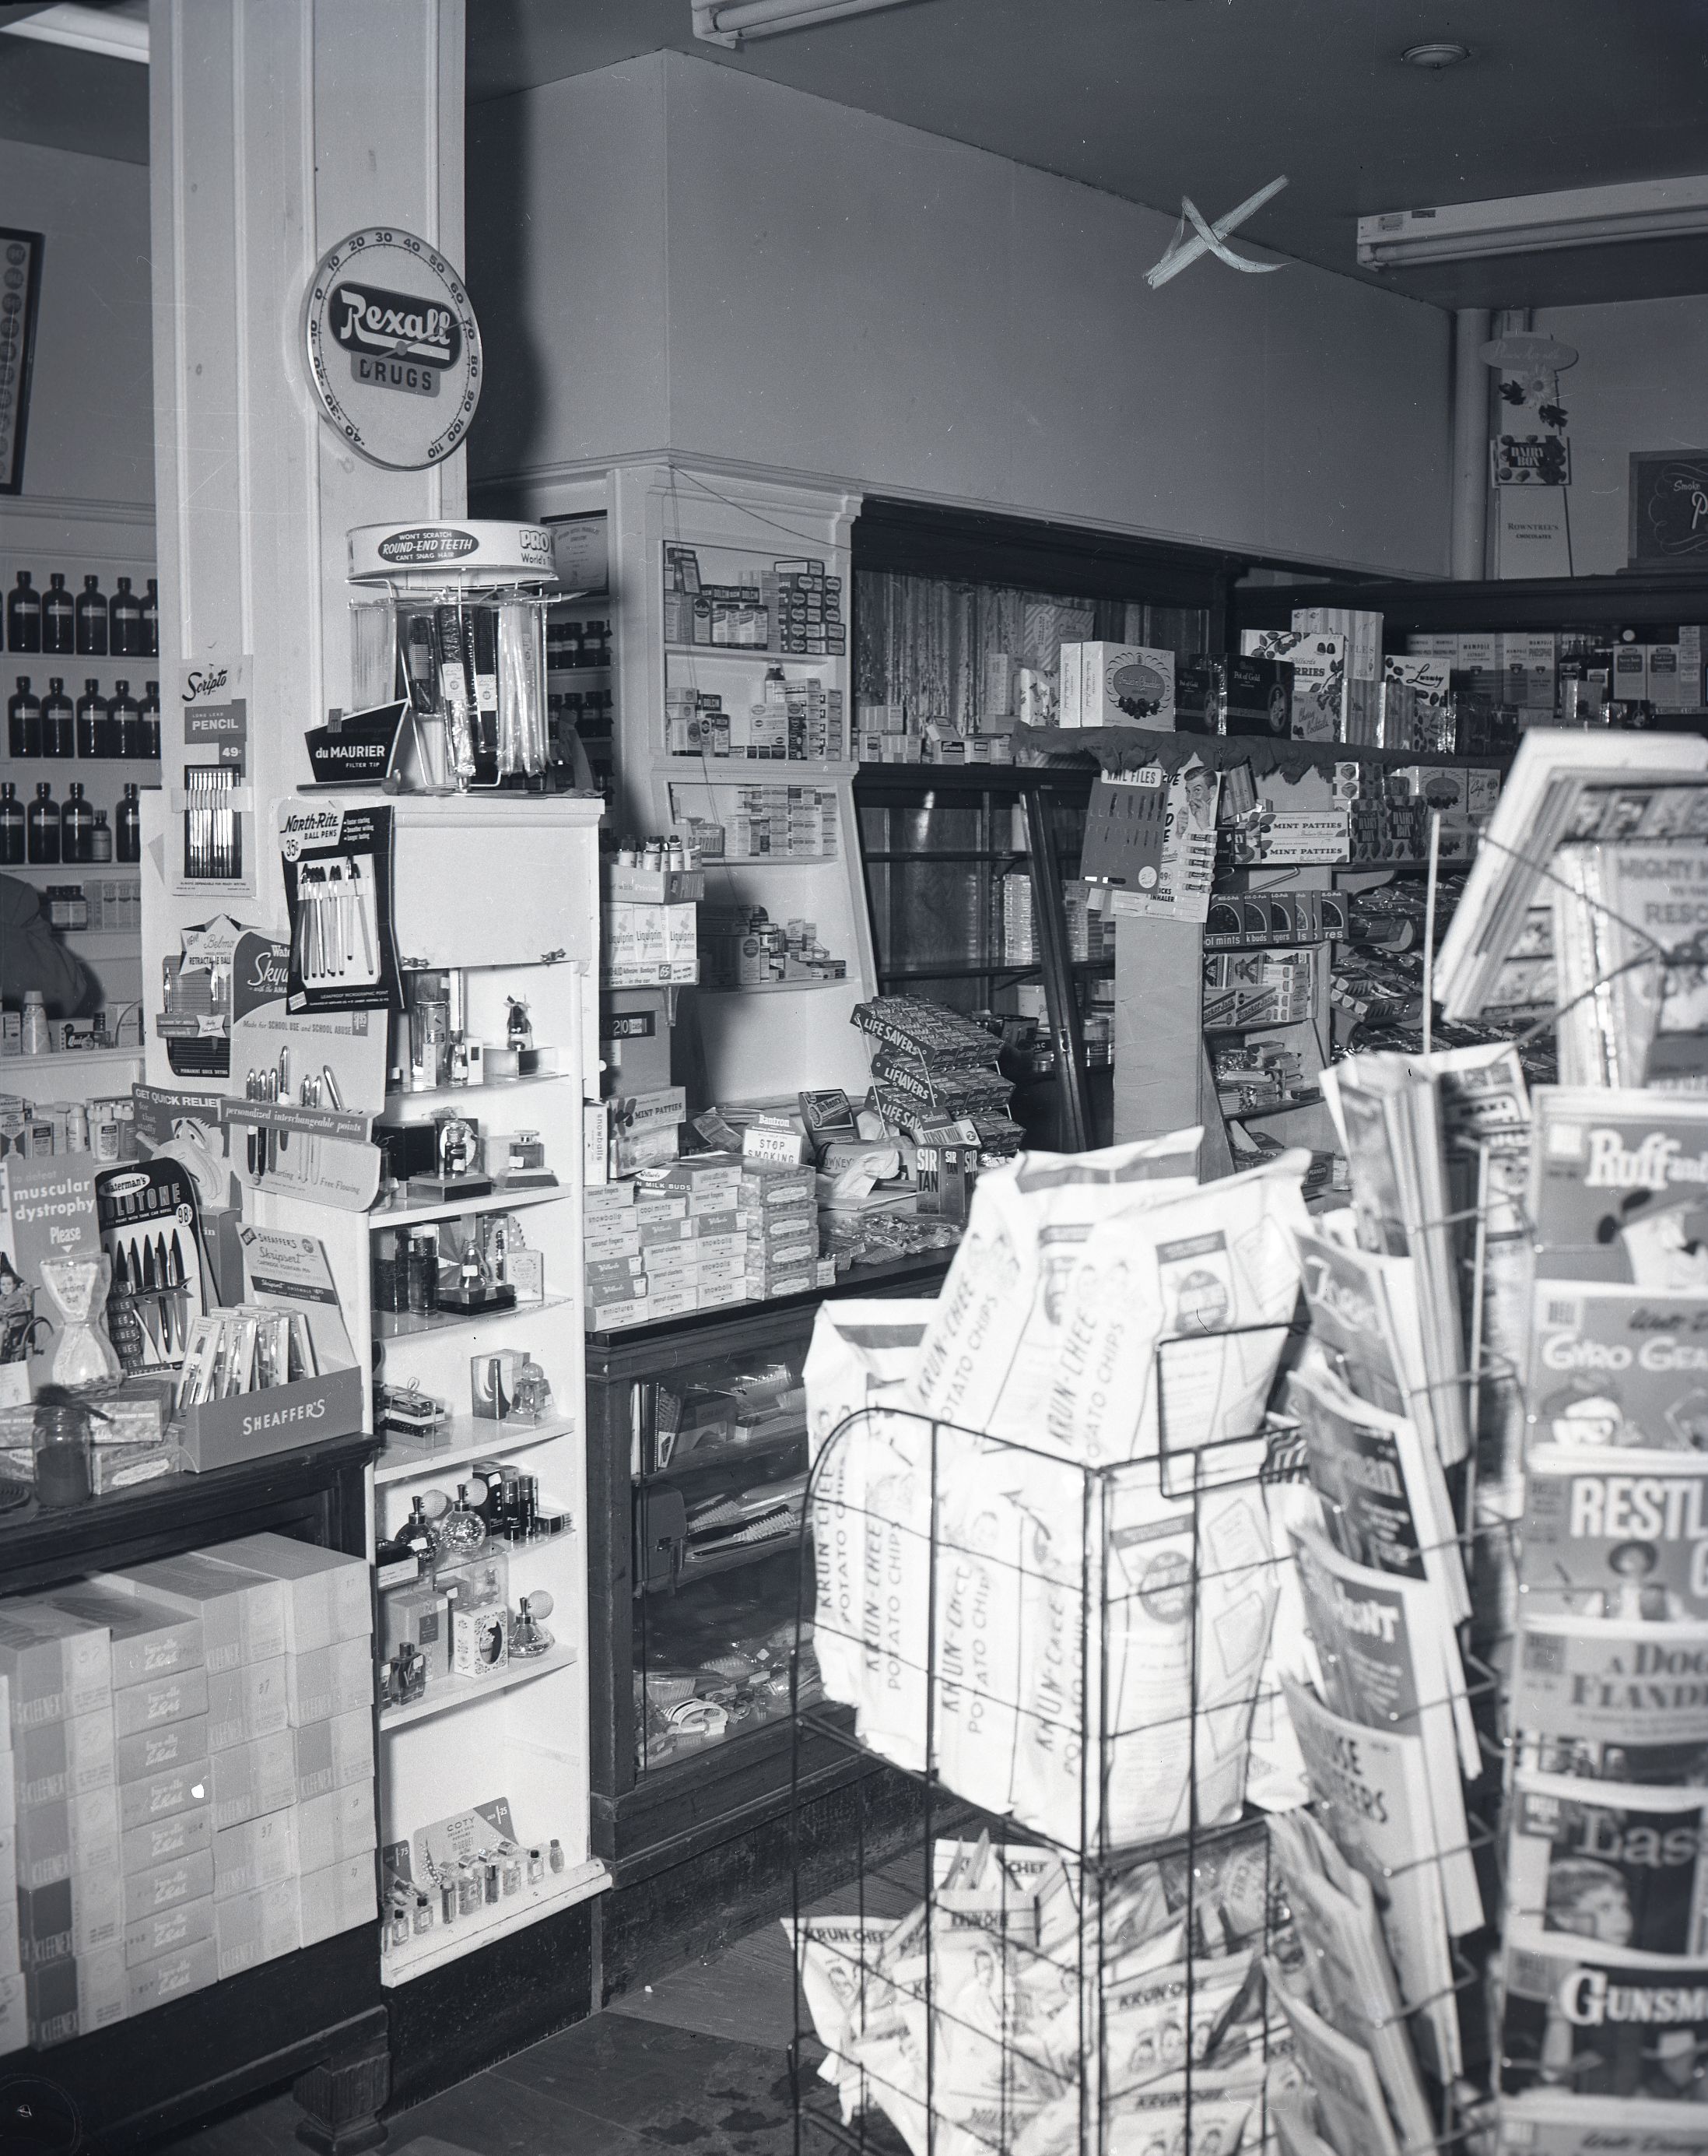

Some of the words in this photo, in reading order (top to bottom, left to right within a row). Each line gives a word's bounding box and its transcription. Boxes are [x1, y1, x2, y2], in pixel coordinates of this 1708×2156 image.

[349, 236, 365, 251] 20
[375, 232, 392, 242] 30
[403, 237, 421, 253] 40
[328, 255, 340, 272] 10
[429, 255, 446, 274] 50
[314, 288, 324, 300] 0
[450, 282, 465, 304] 60
[340, 289, 451, 353] Rexall
[465, 317, 475, 340] 70
[470, 355, 479, 377] 80
[359, 359, 432, 391] DRUGS
[463, 391, 475, 413] 90
[447, 419, 465, 442] 100
[428, 442, 445, 459] 110
[1511, 447, 1544, 457] DAIRY
[1517, 457, 1540, 466] BOX
[1674, 479, 1700, 491] Smoke
[382, 541, 437, 554] ROUND-END
[440, 539, 472, 550] TEETH
[521, 553, 545, 565] World's
[1406, 663, 1444, 688] Luxury
[182, 669, 228, 701] Scripto
[192, 718, 238, 730] PENCIL
[222, 747, 242, 757] 49¢
[316, 746, 328, 759] du
[330, 745, 385, 757] MAURIER
[1132, 770, 1156, 784] FILES
[280, 813, 339, 834] North-Rite
[286, 839, 299, 857] 35¢
[637, 930, 661, 942] Liquiprin
[671, 931, 695, 943] Liquiprin
[1216, 936, 1240, 945] mints
[243, 1020, 257, 1029] Made
[268, 1022, 289, 1031] SCHOOL
[290, 1023, 300, 1031] USE
[312, 1024, 332, 1034] SCHOOL
[334, 1025, 352, 1035] ABUSE
[864, 1018, 883, 1037] LIFE
[884, 1026, 920, 1055] SAVERS
[135, 1089, 150, 1100] GET
[152, 1090, 181, 1105] QUICK
[139, 1101, 149, 1111] for
[634, 1108, 654, 1120] MINT
[654, 1102, 682, 1115] PATTIES
[882, 1103, 901, 1121] LIFE
[226, 1106, 271, 1119] personalized
[274, 1111, 335, 1129] interchangeable
[336, 1121, 361, 1132] points
[758, 1115, 790, 1127] Bantron
[759, 1139, 785, 1150] STOP
[749, 1150, 794, 1164] SMOKING
[917, 1148, 938, 1171] SIR
[945, 1150, 957, 1163] SIR
[964, 1150, 977, 1173] SIR
[946, 1163, 958, 1175] TAN
[103, 1176, 146, 1193] Waterman's
[319, 1178, 334, 1188] Free
[917, 1170, 938, 1192] TAN
[13, 1178, 91, 1201] muscular
[15, 1196, 96, 1223] dystrophy
[50, 1226, 81, 1245] Please
[702, 1262, 731, 1270] snowballs
[704, 1284, 732, 1294] snowballs
[919, 1270, 976, 1405] KRUN-CHEE
[1047, 1305, 1099, 1445] KRUN-CHEE
[243, 1399, 325, 1435] SHEAFFER'S
[447, 1816, 475, 1832] COTY
